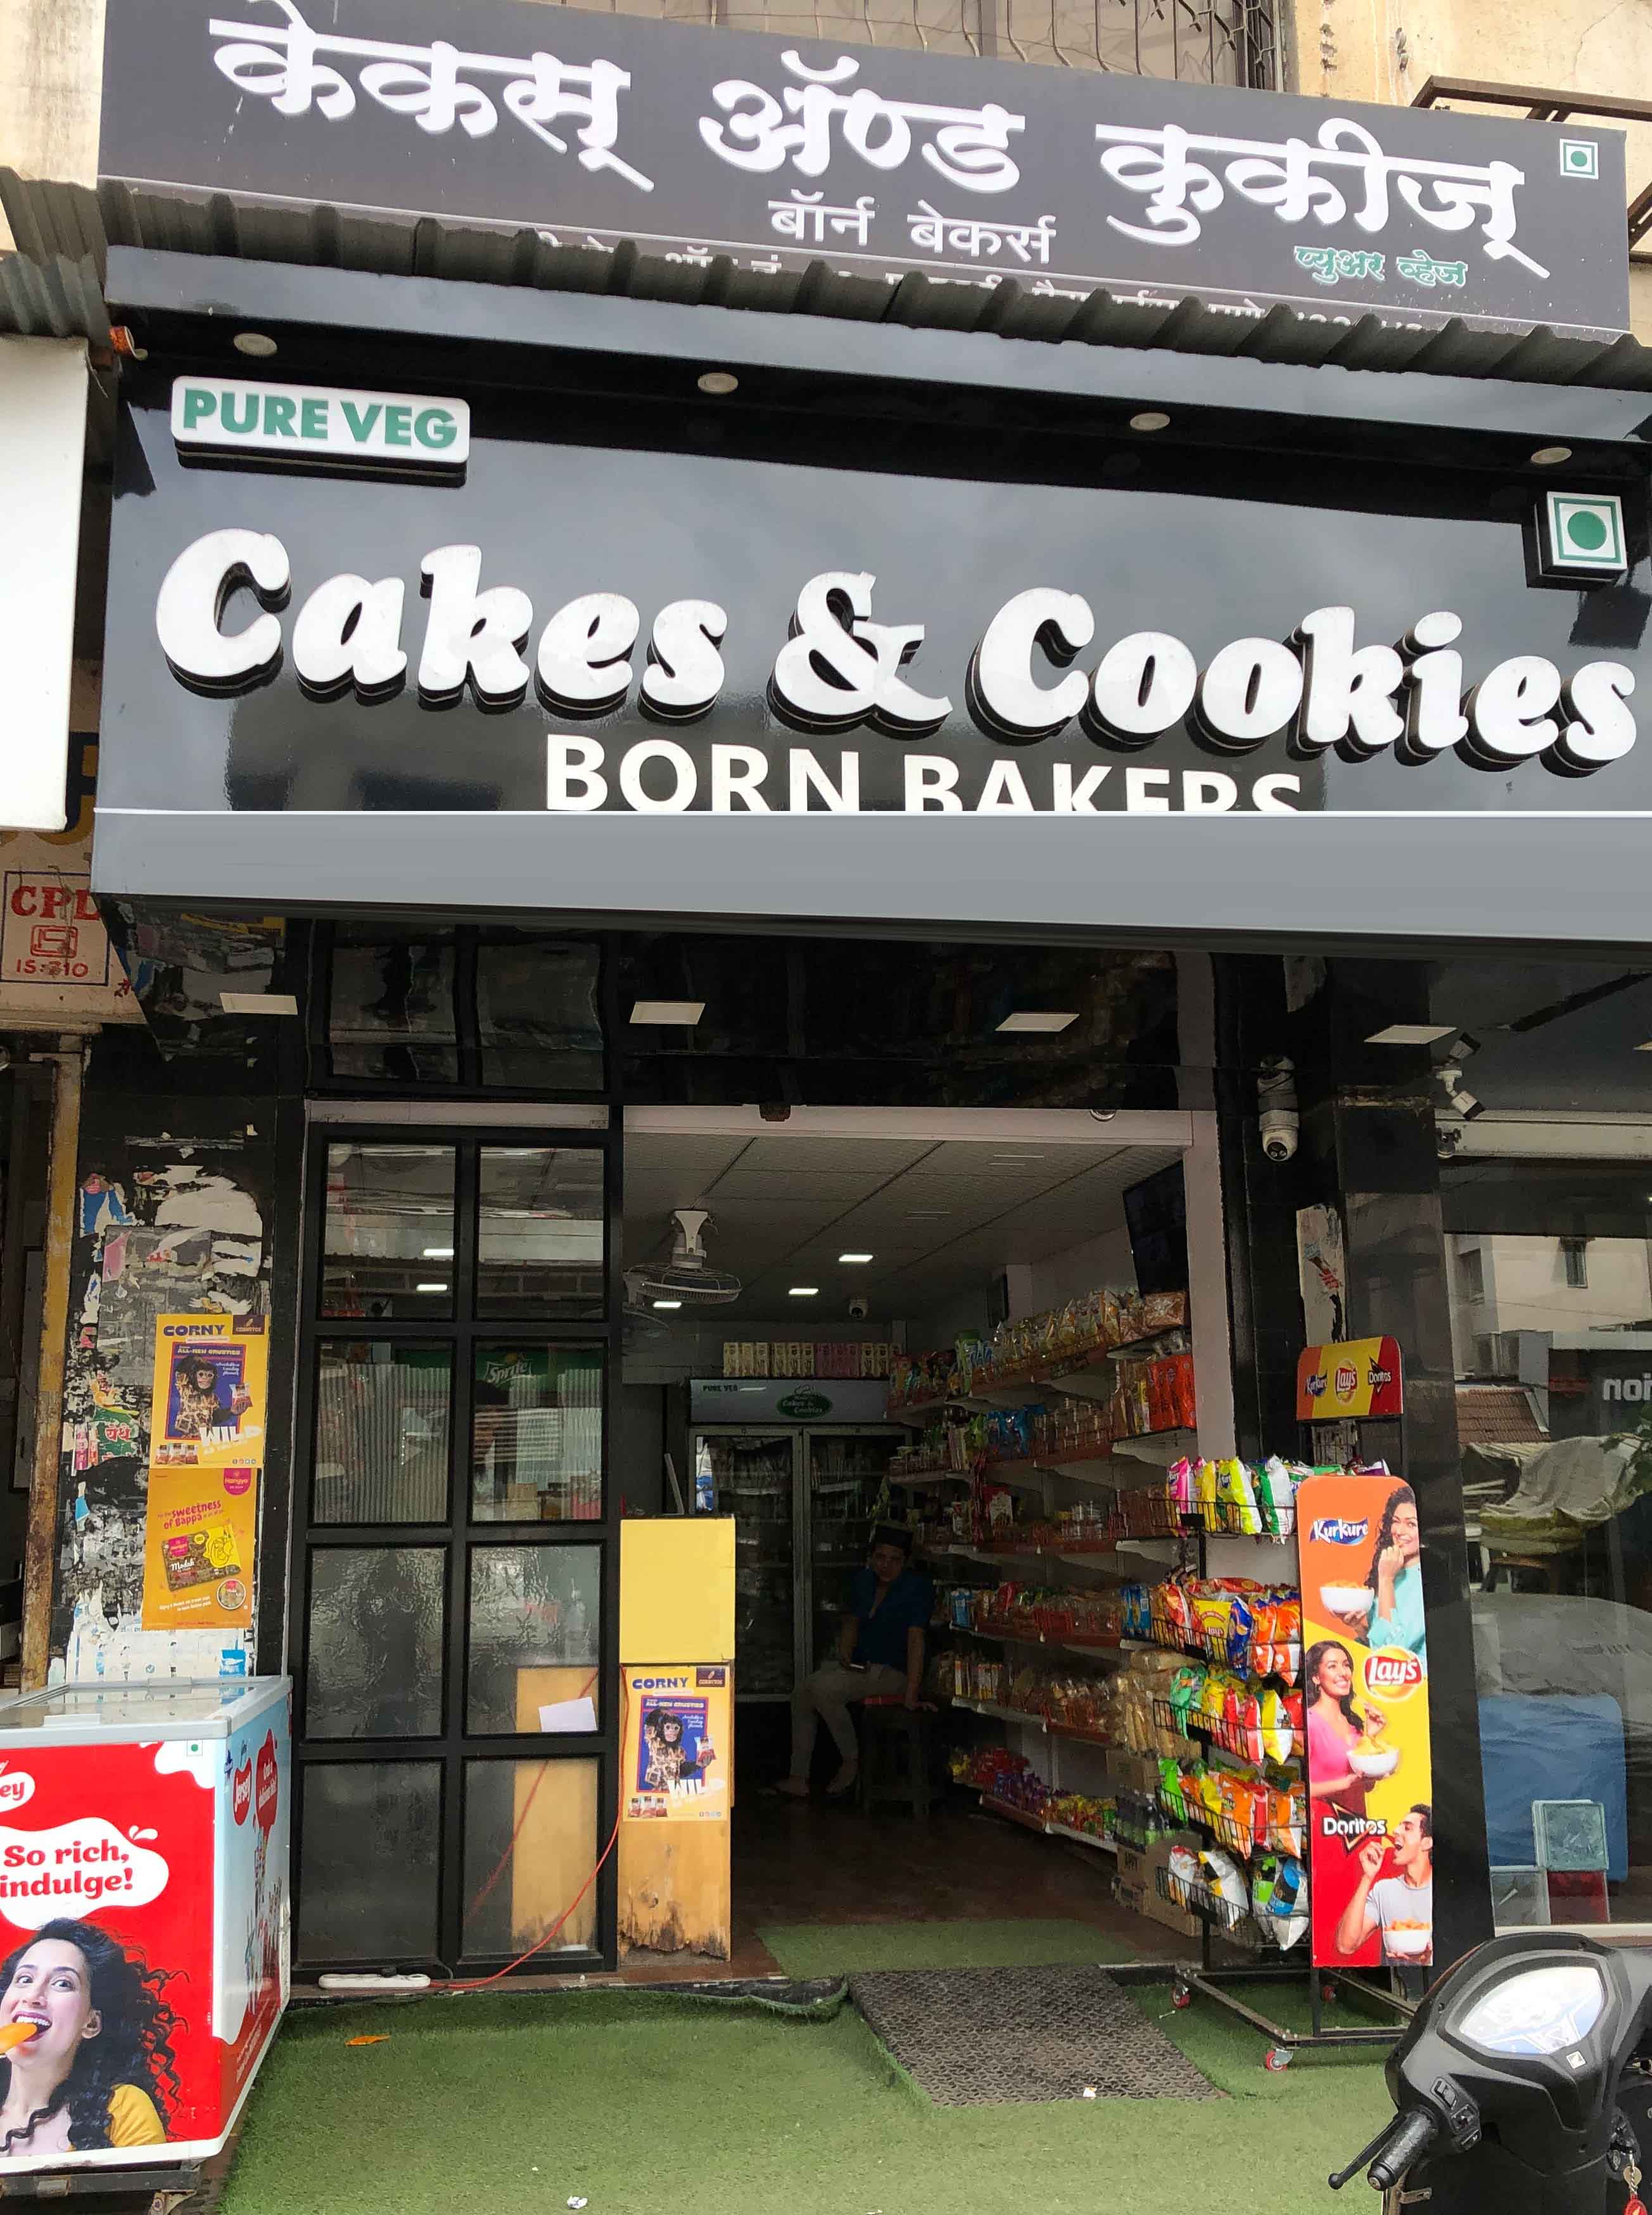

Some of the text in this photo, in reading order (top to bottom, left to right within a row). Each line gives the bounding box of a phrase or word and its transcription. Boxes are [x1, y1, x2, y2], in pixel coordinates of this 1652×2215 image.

[1095, 117, 1549, 278] कुकीज्
[768, 189, 1056, 264] बॉर्न बेकर्स
[1294, 245, 1468, 286] प्युअर व्हेज
[183, 388, 457, 449] PURE VEG
[155, 528, 1637, 763] Cakes & Cookies
[547, 733, 860, 811] BORN
[163, 1324, 225, 1336] CORNY
[487, 1360, 528, 1384] Sprite
[1368, 1371, 1392, 1384] Doritos
[163, 1519, 173, 1529] of
[175, 1514, 203, 1528] Bappa
[172, 1500, 222, 1518] sweetness
[1311, 1517, 1369, 1545] Kurkure
[170, 1557, 196, 1571] Modak
[632, 1677, 689, 1690] CORNY
[1323, 1816, 1387, 1836] Doritos
[4, 1839, 129, 1867] So rich,
[0, 1867, 133, 1899] indulge!
